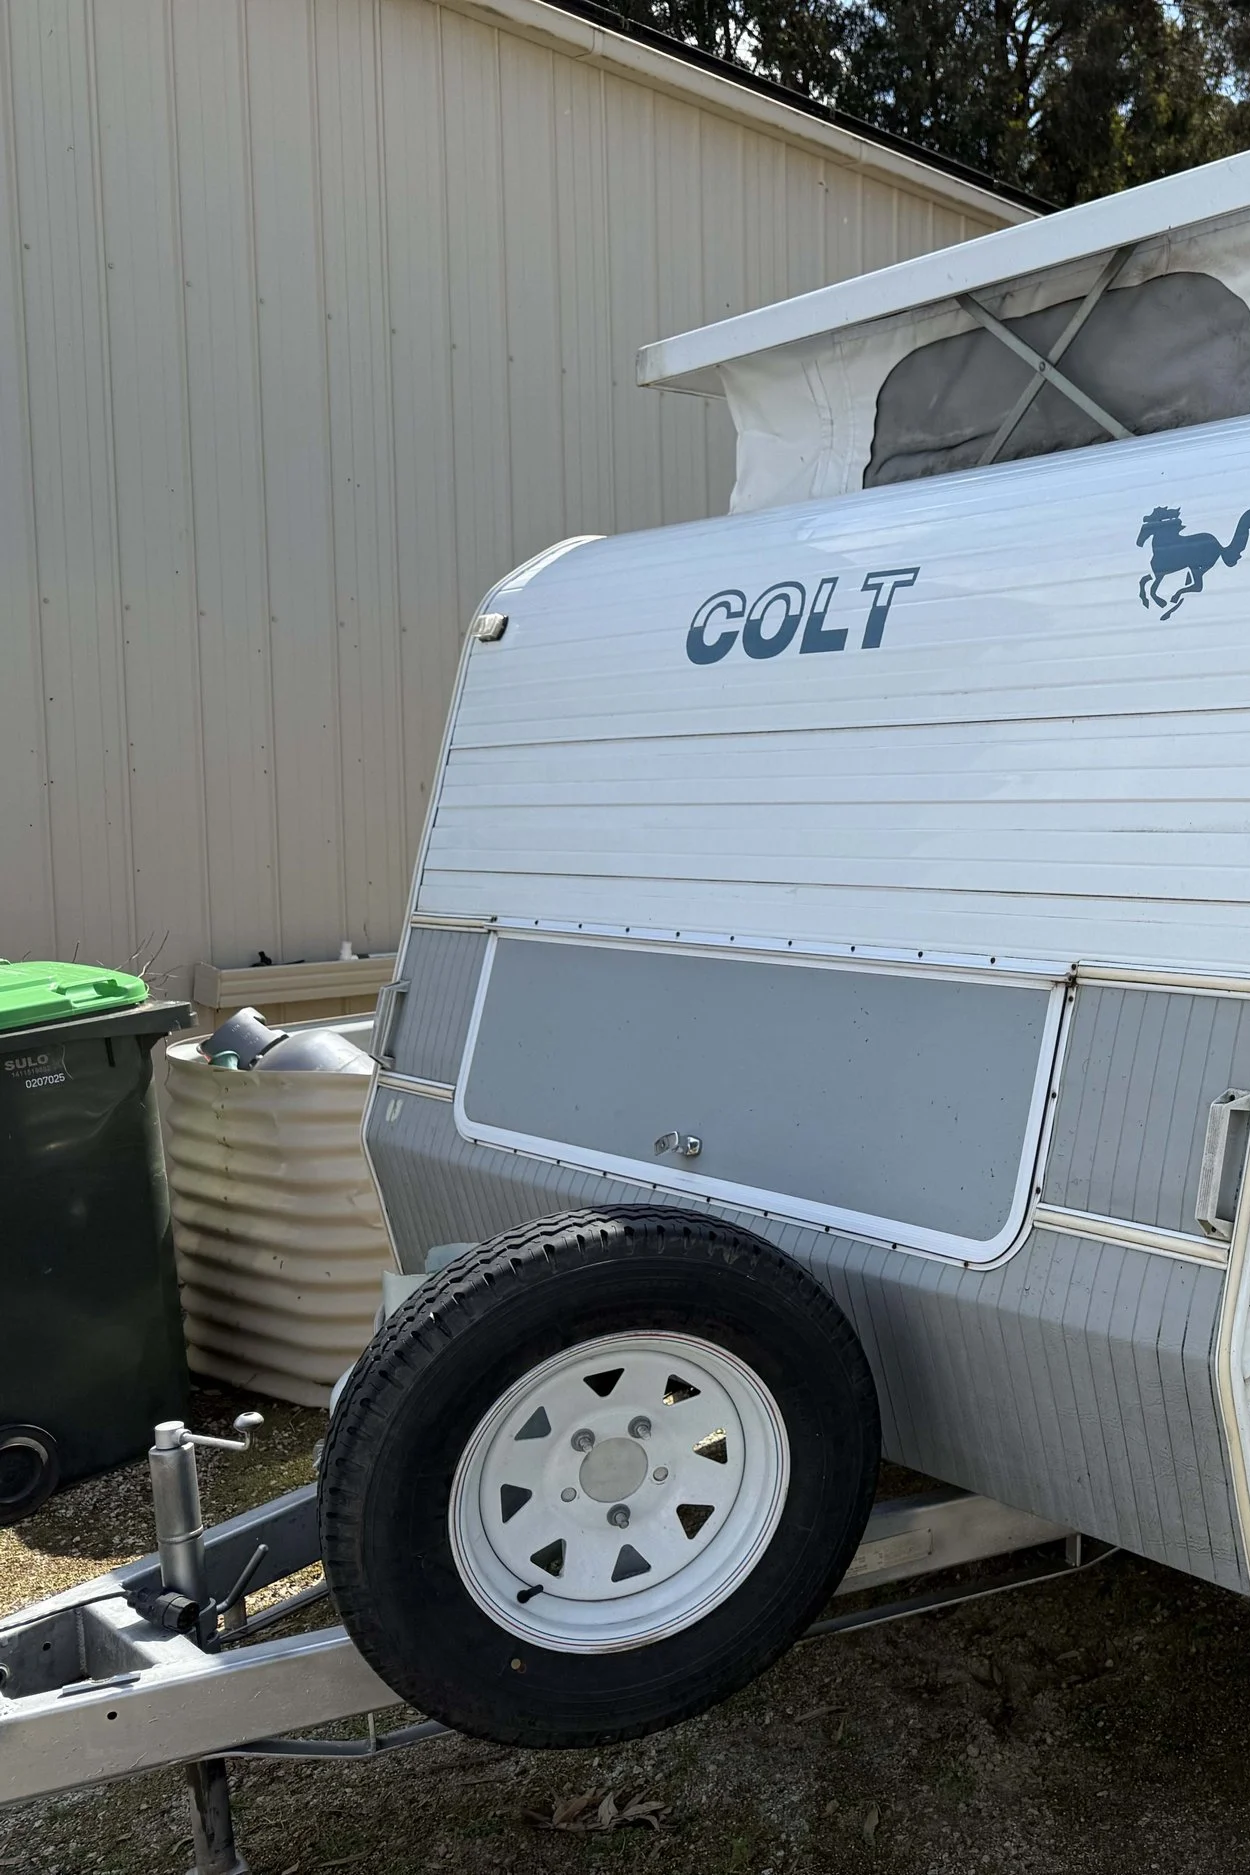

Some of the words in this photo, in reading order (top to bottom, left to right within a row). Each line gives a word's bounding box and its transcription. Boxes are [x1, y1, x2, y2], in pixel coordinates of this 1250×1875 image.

[685, 566, 921, 666] COLT
[3, 1054, 49, 1071] SULO
[25, 1073, 66, 1089] 0207025
